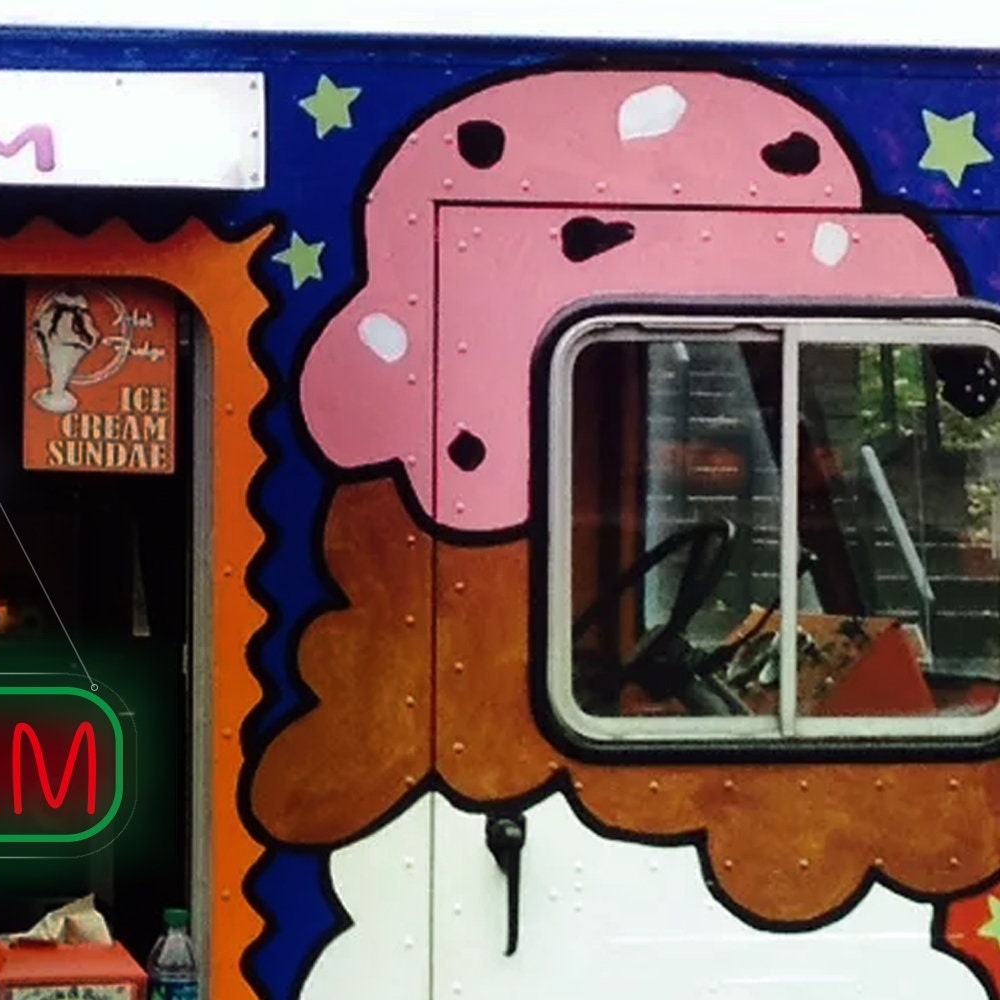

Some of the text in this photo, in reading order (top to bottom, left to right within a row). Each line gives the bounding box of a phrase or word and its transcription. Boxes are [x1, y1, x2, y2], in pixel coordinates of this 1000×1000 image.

[120, 386, 167, 413] ICE
[61, 413, 167, 441] CREAM
[47, 441, 167, 469] SUNDAE
